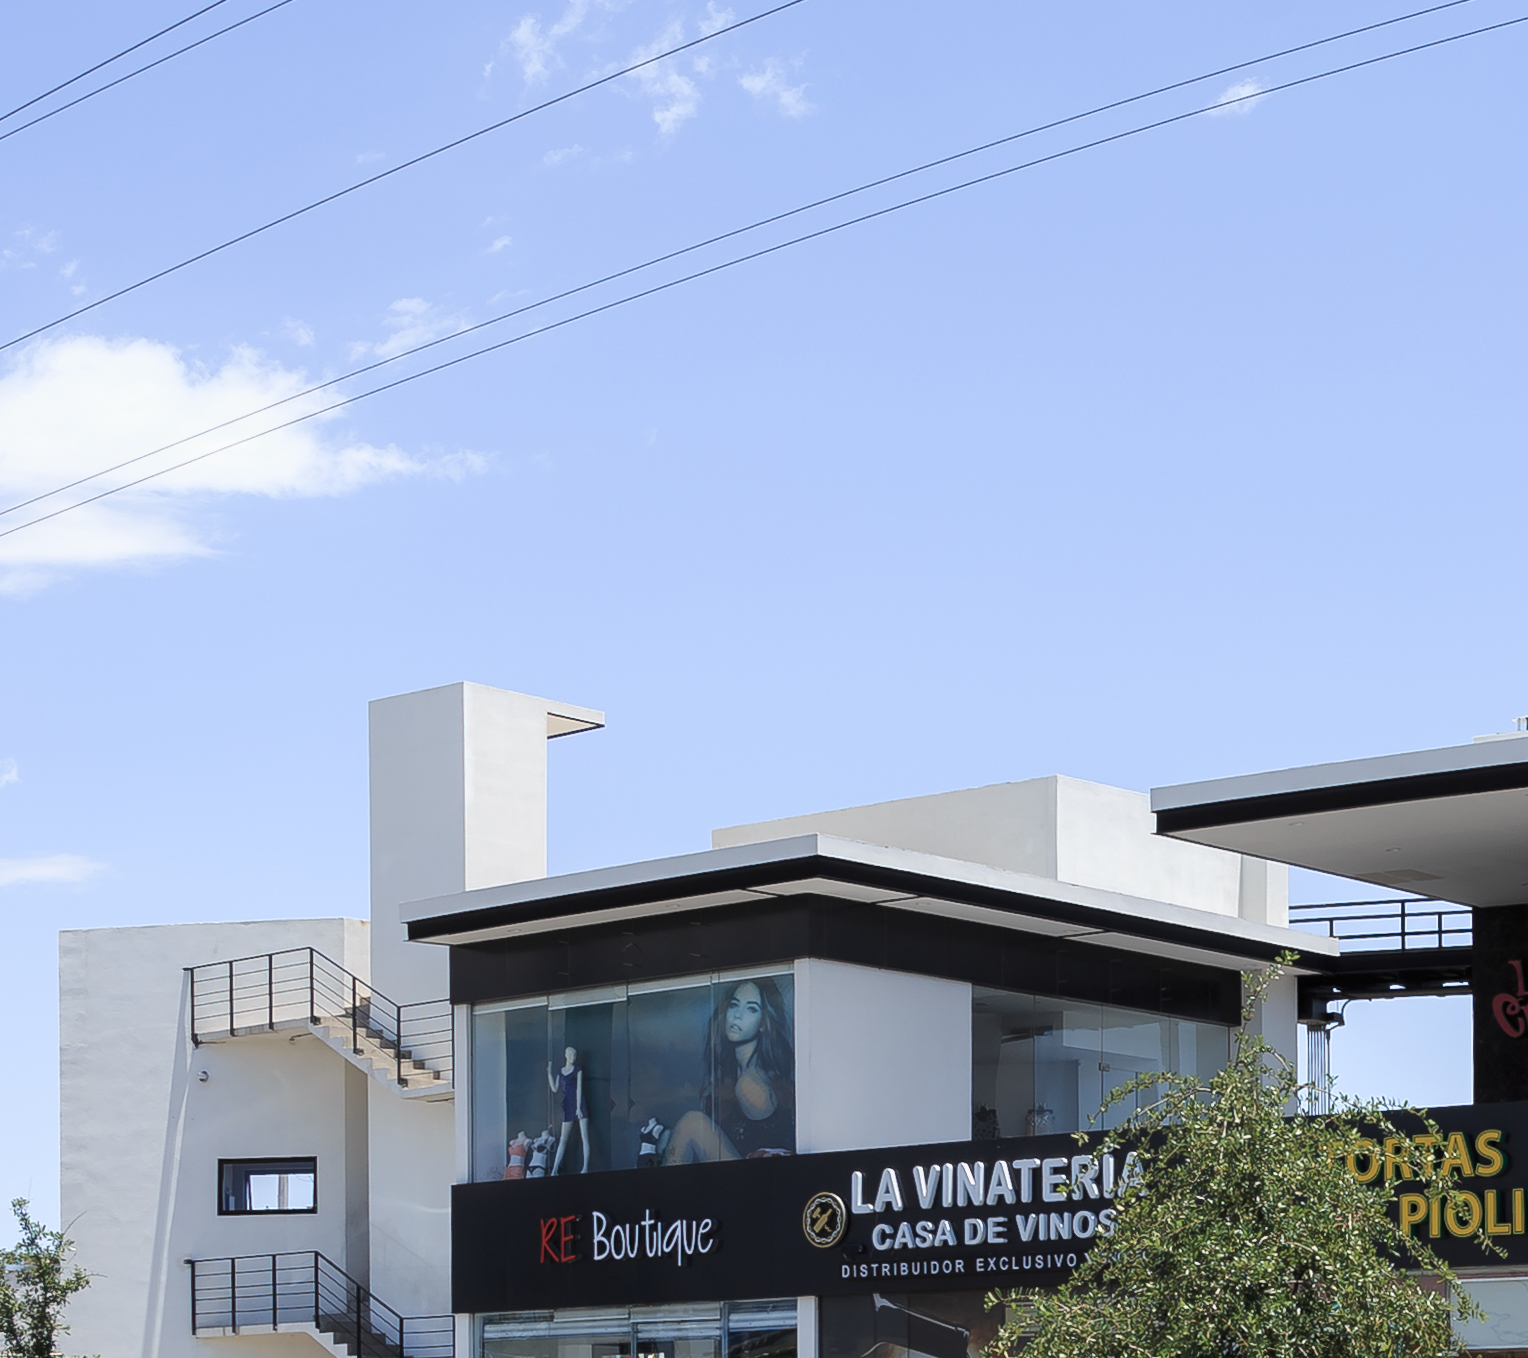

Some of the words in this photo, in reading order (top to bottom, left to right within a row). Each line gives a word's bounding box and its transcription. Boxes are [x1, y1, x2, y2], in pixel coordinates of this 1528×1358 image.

[1318, 1128, 1508, 1185] ORTAS
[850, 1167, 904, 1215] LA
[540, 1215, 577, 1264] RE
[592, 1208, 714, 1267] Boutique
[872, 1221, 957, 1251] CASA
[964, 1216, 1009, 1246] DE
[1015, 1208, 1118, 1242] VINOS
[841, 1260, 966, 1279] DISTRIBUIDOR
[975, 1252, 1078, 1273] EXCLUSIVO
